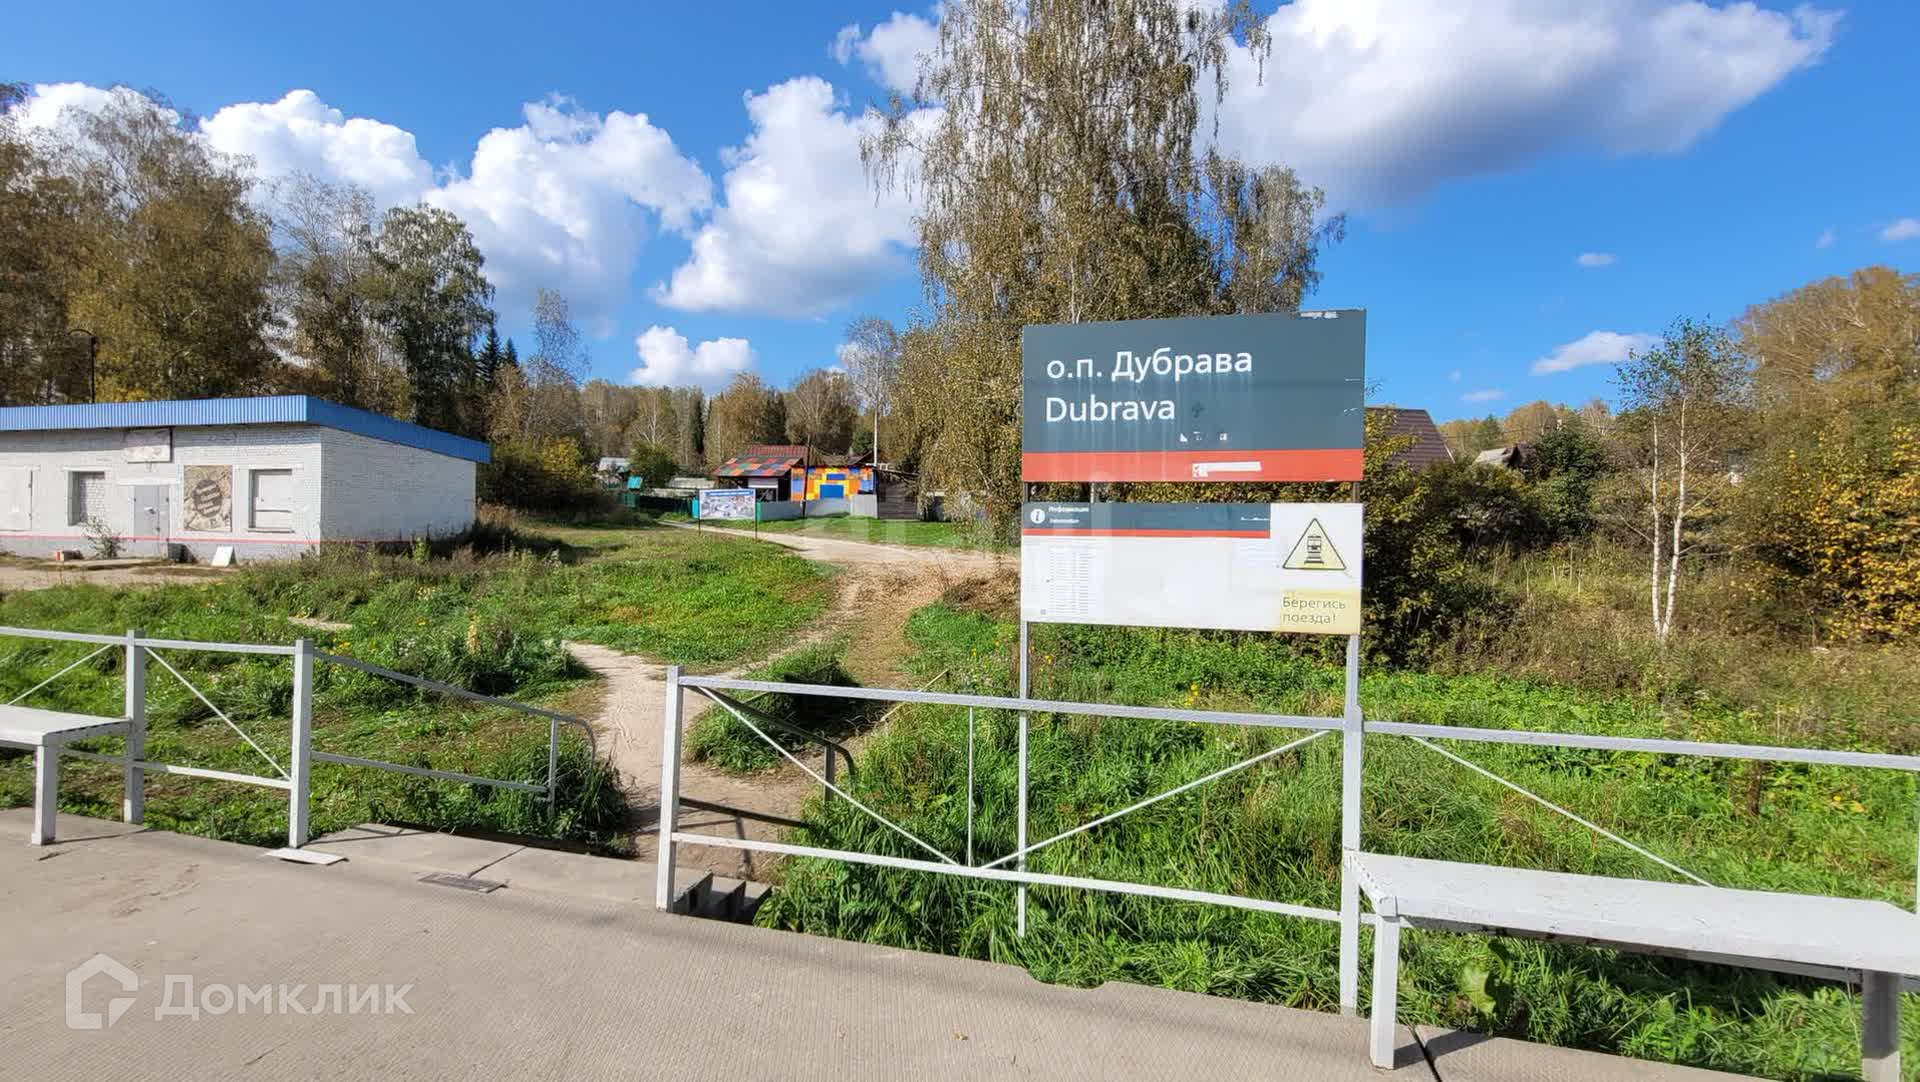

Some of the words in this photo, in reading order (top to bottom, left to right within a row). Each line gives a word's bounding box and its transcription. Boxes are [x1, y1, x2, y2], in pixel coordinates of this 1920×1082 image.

[1046, 359, 1103, 380] о.п.
[1111, 347, 1253, 382] Дубрава
[1045, 394, 1176, 423] Dubrava
[1282, 597, 1346, 610] Берегись
[1282, 613, 1336, 624] поезда!
